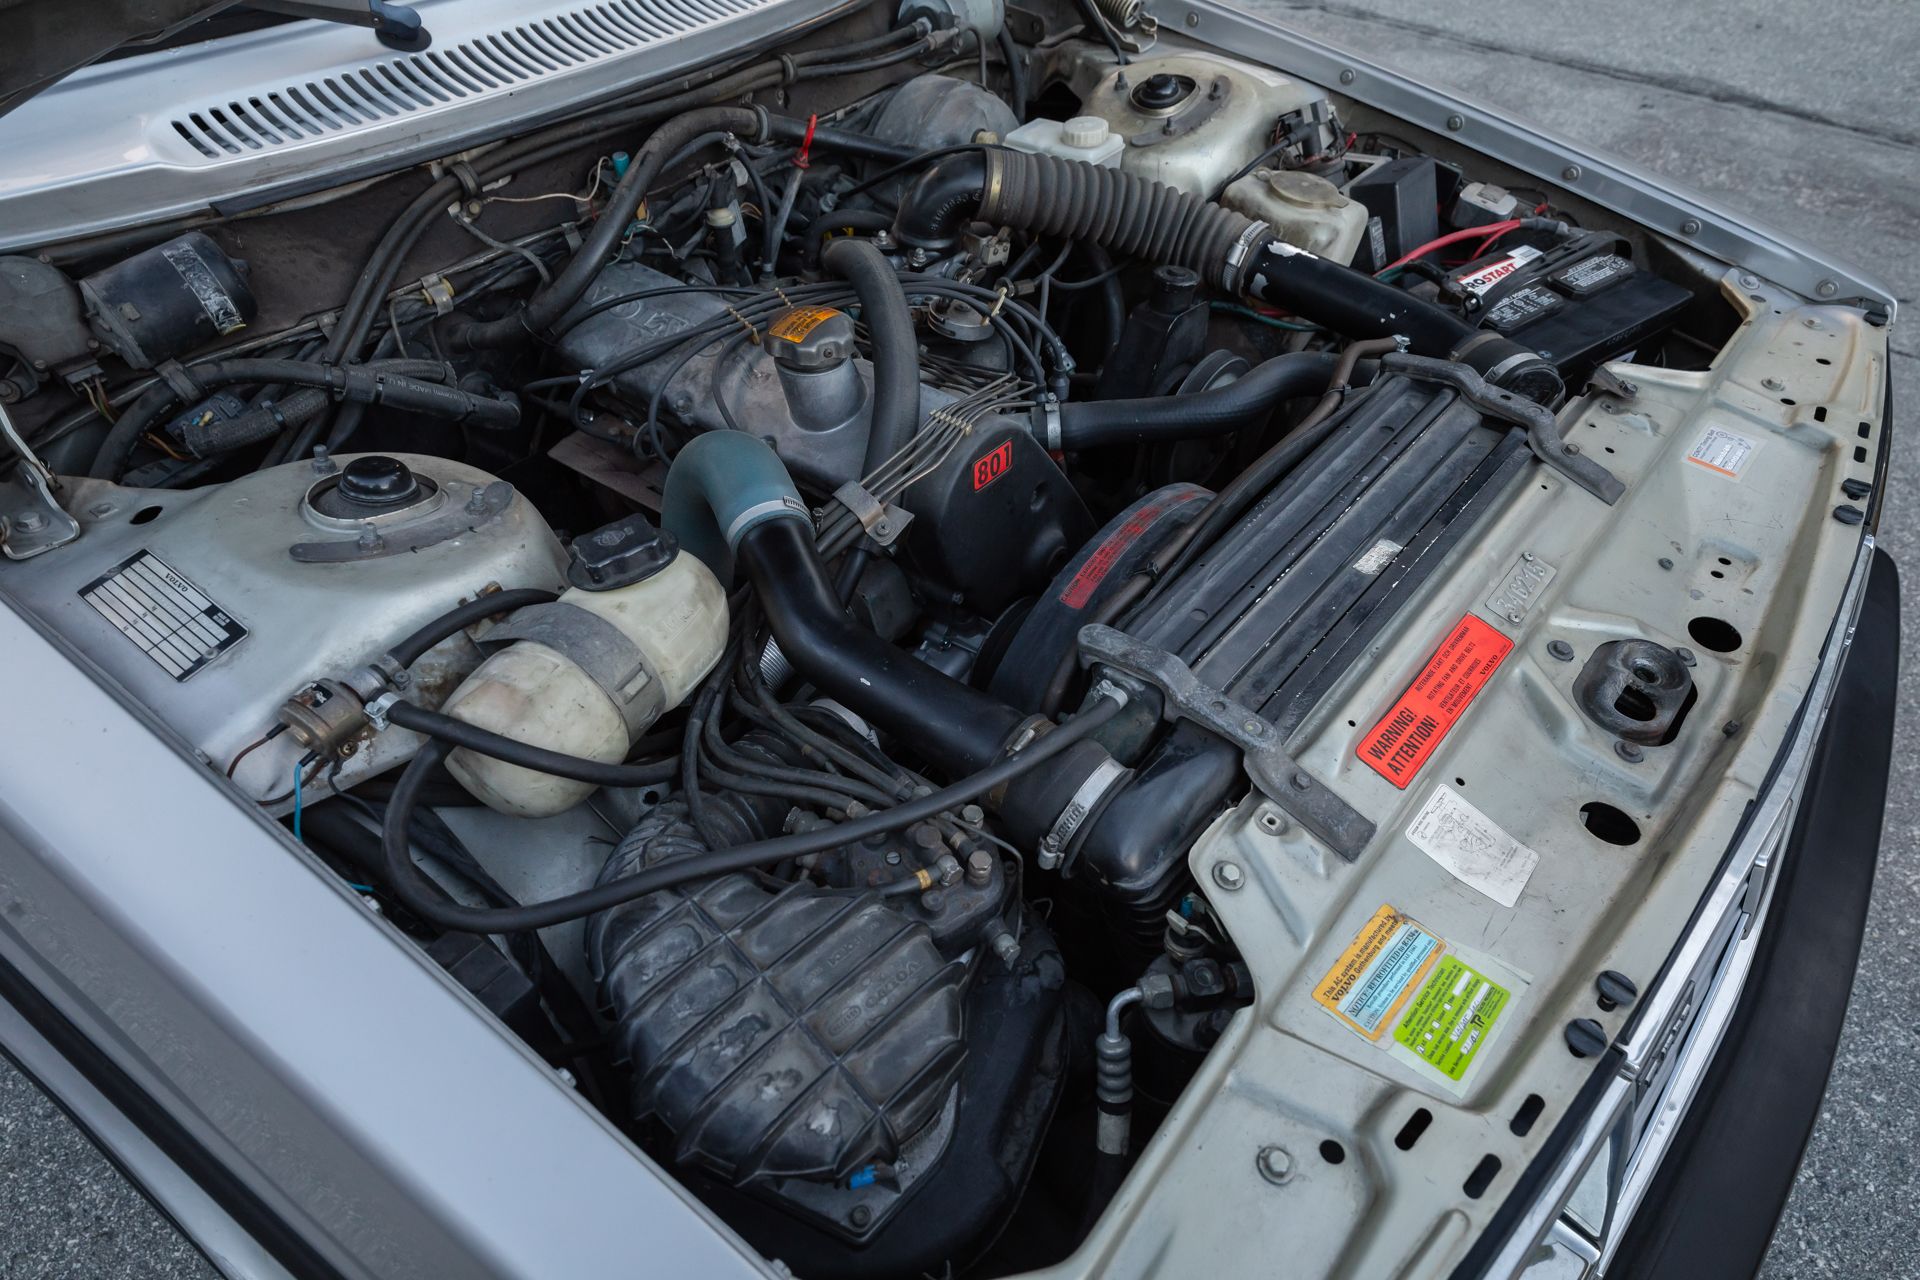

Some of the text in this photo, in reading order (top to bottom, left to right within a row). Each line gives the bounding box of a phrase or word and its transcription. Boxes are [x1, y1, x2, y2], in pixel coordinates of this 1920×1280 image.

[977, 447, 1013, 486] 801
[164, 572, 188, 593] VOLVO
[1426, 679, 1445, 701] ROTATING
[1441, 671, 1452, 682] FAN
[1448, 662, 1459, 674] AND
[1454, 651, 1468, 665] DRIVE
[1479, 653, 1498, 676] VOLVO
[1438, 682, 1462, 710] VENTILATEUR
[1446, 706, 1455, 714] EN
[1367, 704, 1417, 762] WARNING!
[1386, 713, 1440, 776] ATTENTION!
[1322, 912, 1393, 998] This AC system is manufactured by
[1331, 971, 1357, 1004] VOLVO
[1353, 942, 1380, 976] Gothenburg
[1376, 933, 1387, 945] and
[1366, 948, 1401, 992] RETROFITTED
[1397, 944, 1405, 952] to
[1402, 1005, 1419, 1029] Attention
[1415, 989, 1431, 1008] Service
